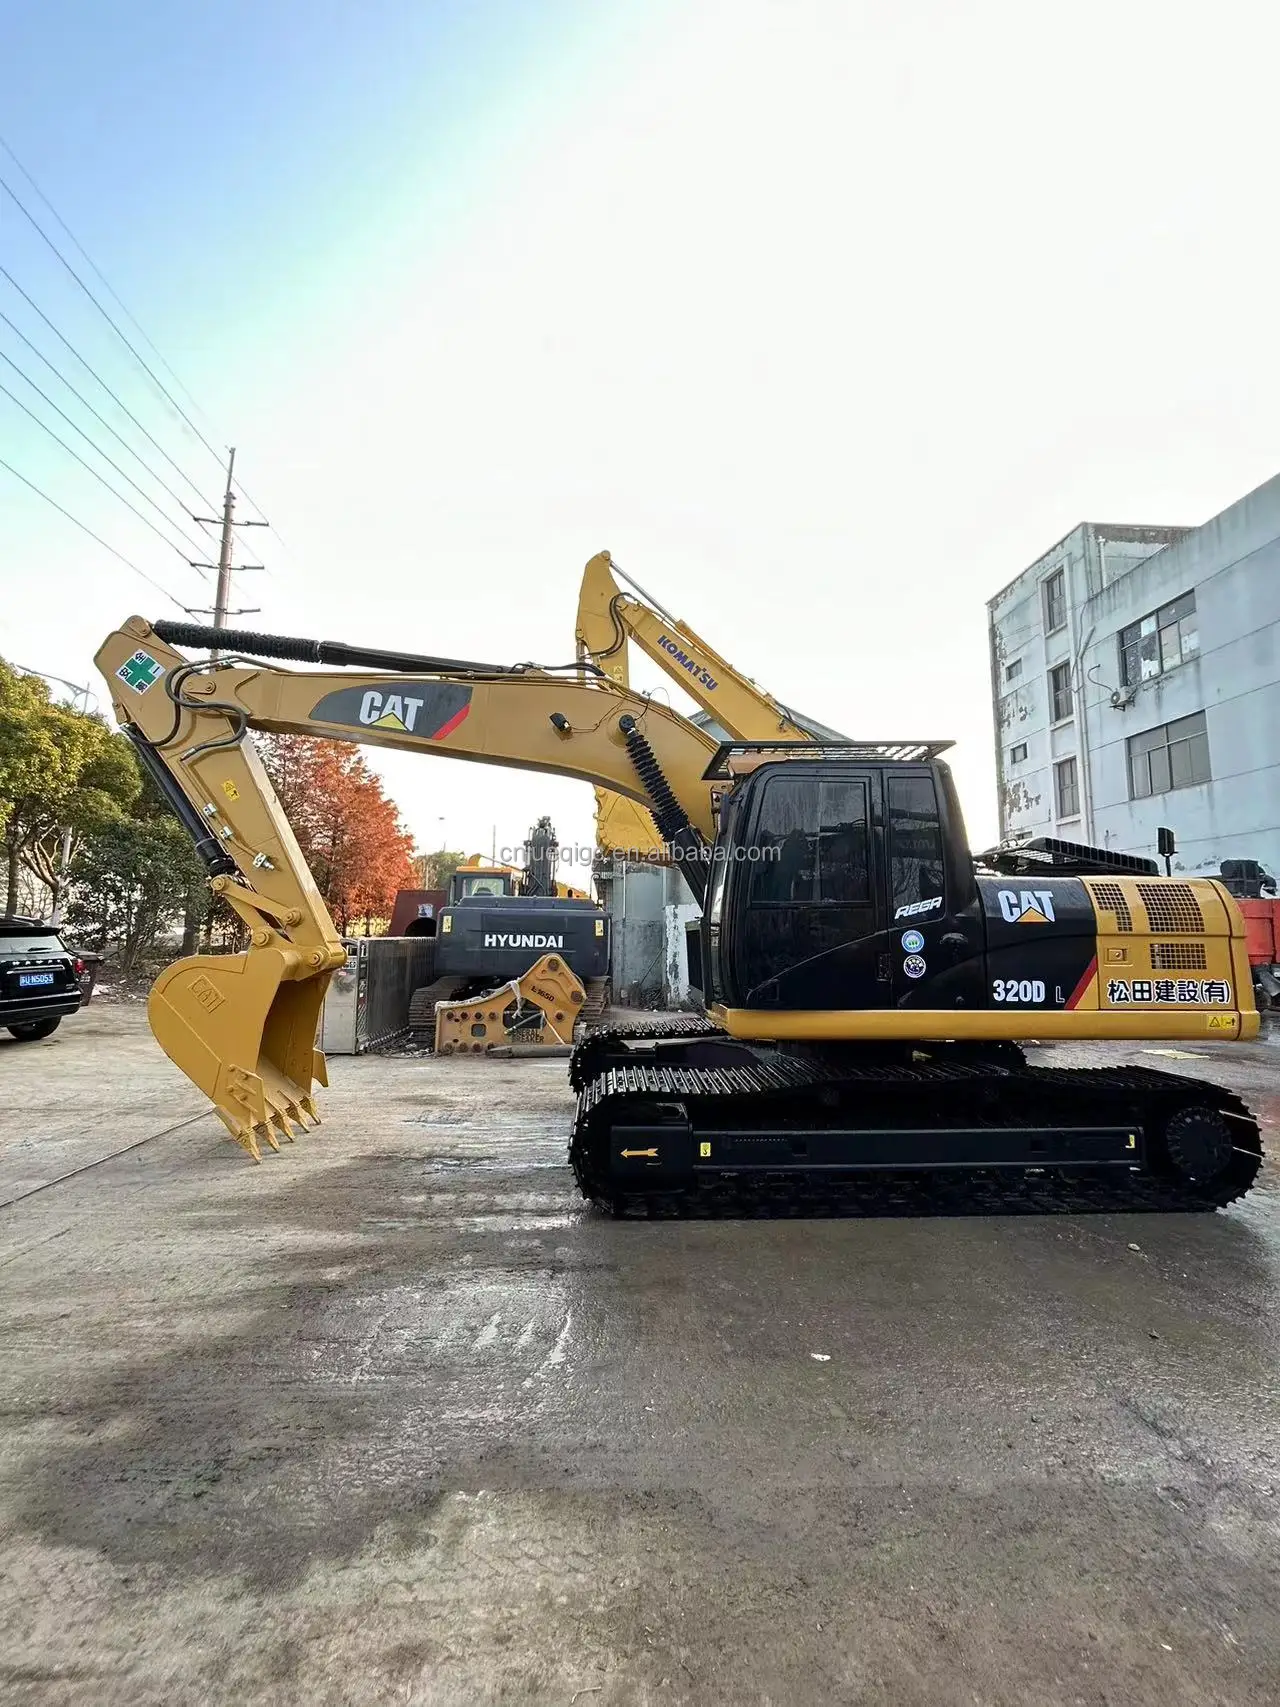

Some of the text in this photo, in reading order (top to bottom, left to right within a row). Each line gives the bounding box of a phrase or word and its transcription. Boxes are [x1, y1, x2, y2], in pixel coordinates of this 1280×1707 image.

[657, 635, 719, 691] KOMATSU
[359, 690, 424, 732] CAT
[894, 896, 943, 920] REGA
[997, 890, 1056, 923] CAT
[484, 934, 564, 948] HYUNDAI
[992, 979, 1065, 1003] 320D L
